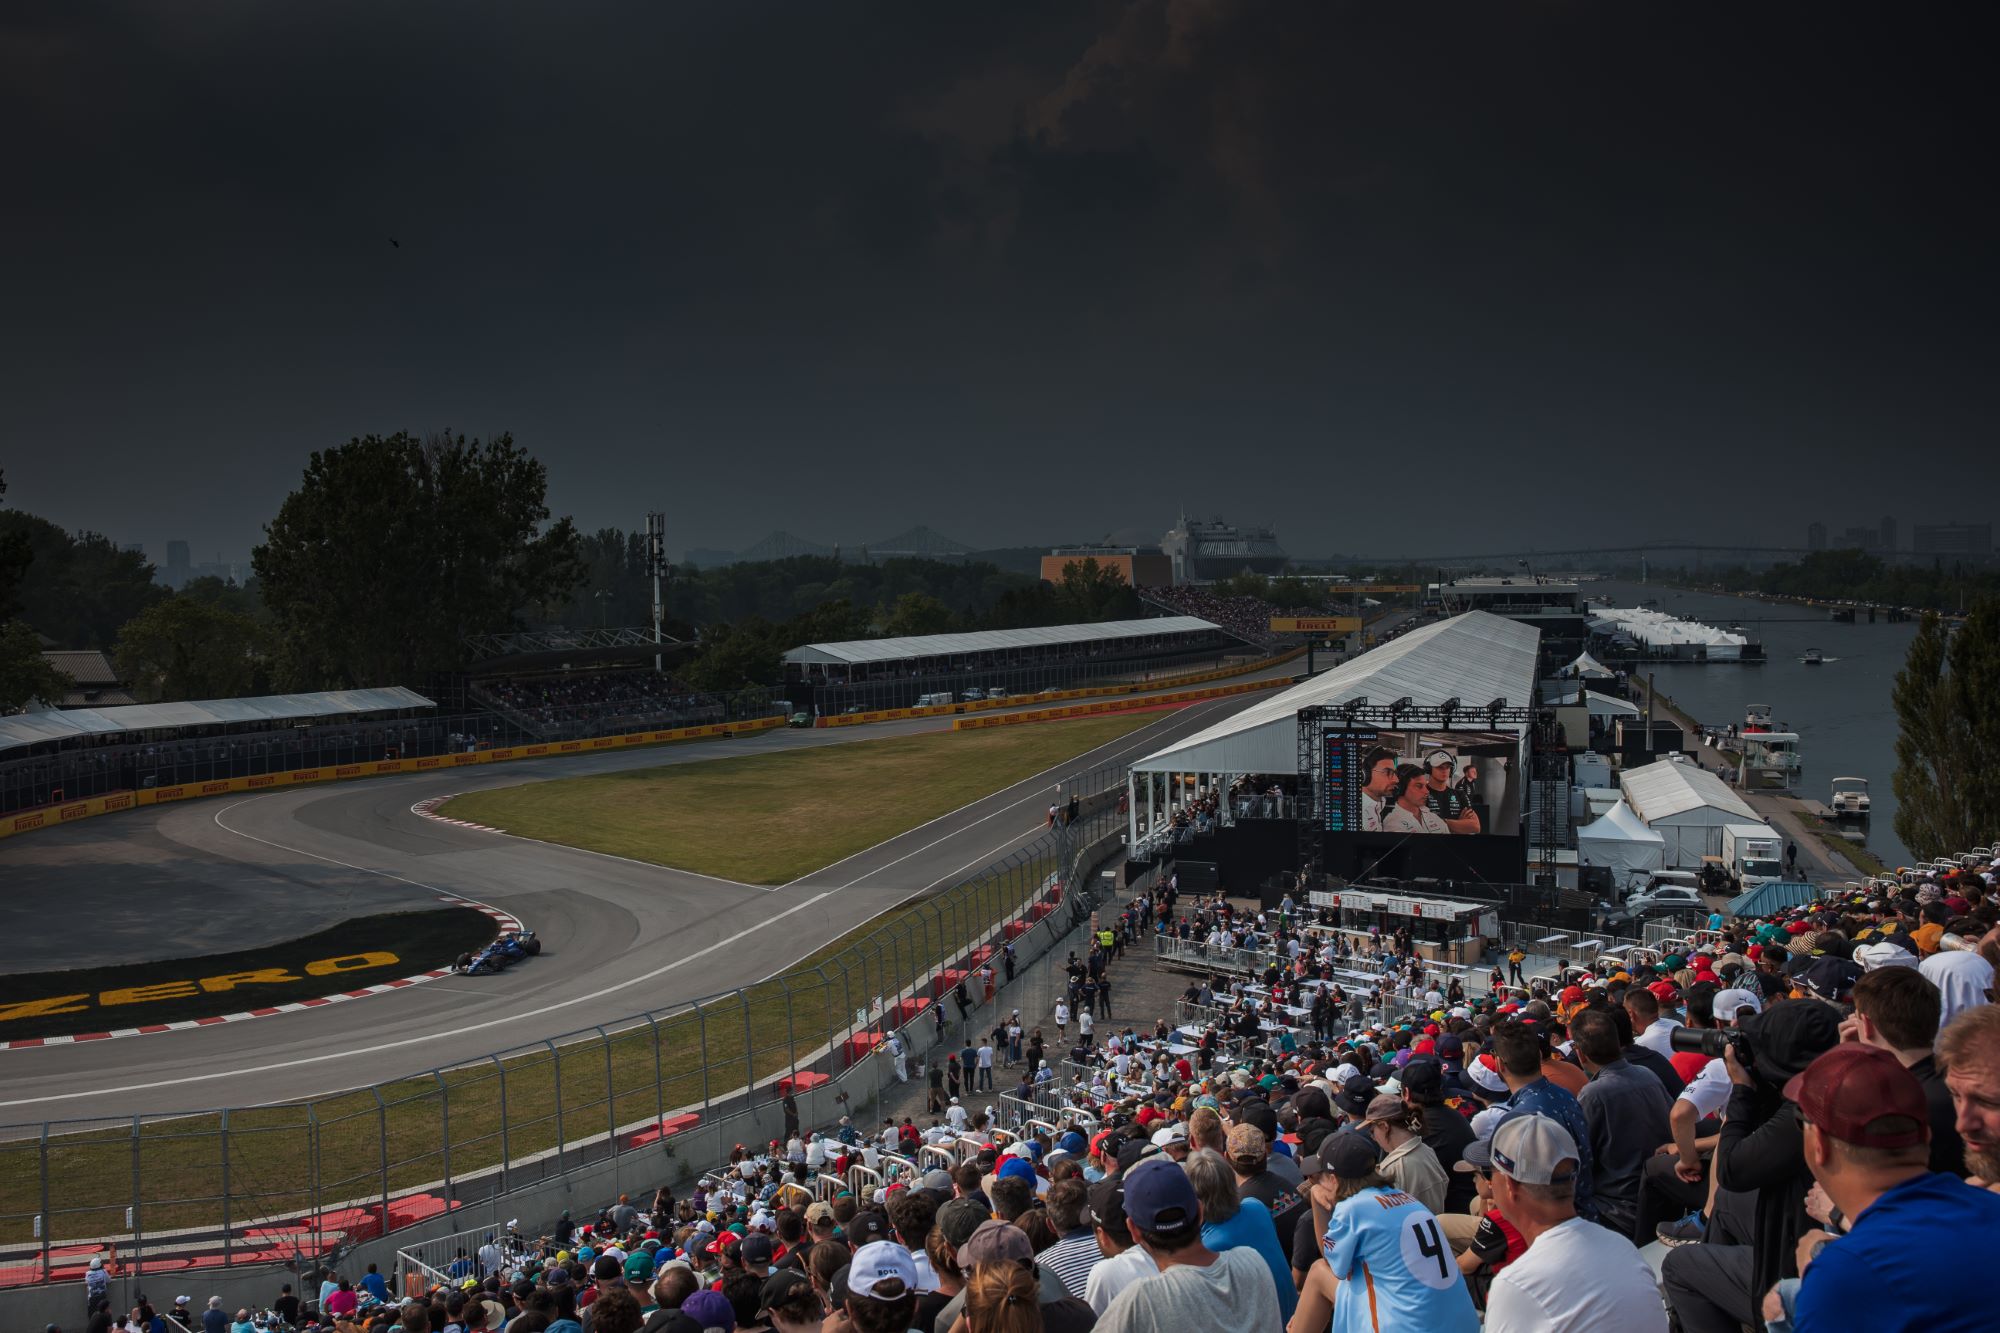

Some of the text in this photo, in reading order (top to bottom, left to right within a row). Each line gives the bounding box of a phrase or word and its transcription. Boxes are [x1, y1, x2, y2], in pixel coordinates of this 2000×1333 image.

[1296, 619, 1336, 630] PIRELLI
[248, 776, 274, 787] PIRELLI
[294, 771, 319, 781] PIRELLI
[156, 788, 184, 799] PIRELLI
[202, 782, 229, 793] PIRELLI
[105, 795, 130, 810] PIRELLI
[61, 803, 87, 820] PIRELLI
[14, 813, 44, 831] PIRELLI
[0, 951, 400, 1021] ZERO
[1411, 1218, 1449, 1279] 4
